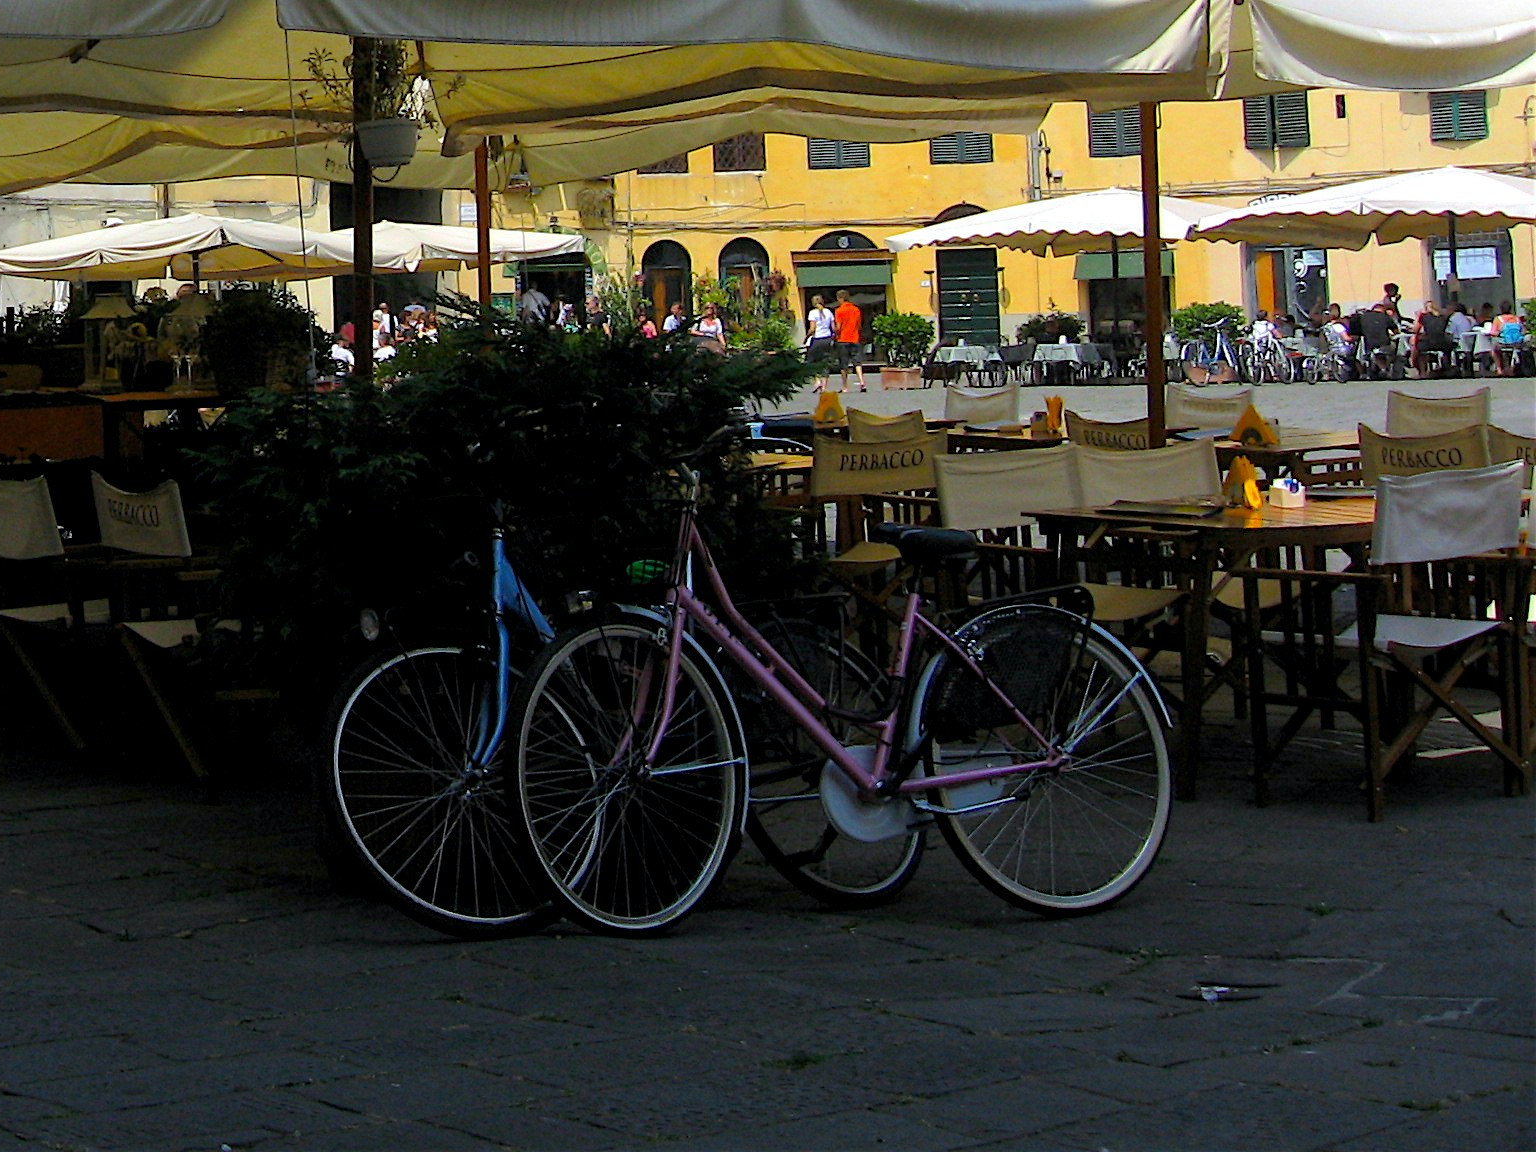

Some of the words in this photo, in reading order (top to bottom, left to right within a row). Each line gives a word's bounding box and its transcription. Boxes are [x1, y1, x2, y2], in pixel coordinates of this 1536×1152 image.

[839, 448, 924, 471] PERBACCO
[1381, 447, 1462, 468] PERBACCO
[1515, 446, 1536, 465] PE
